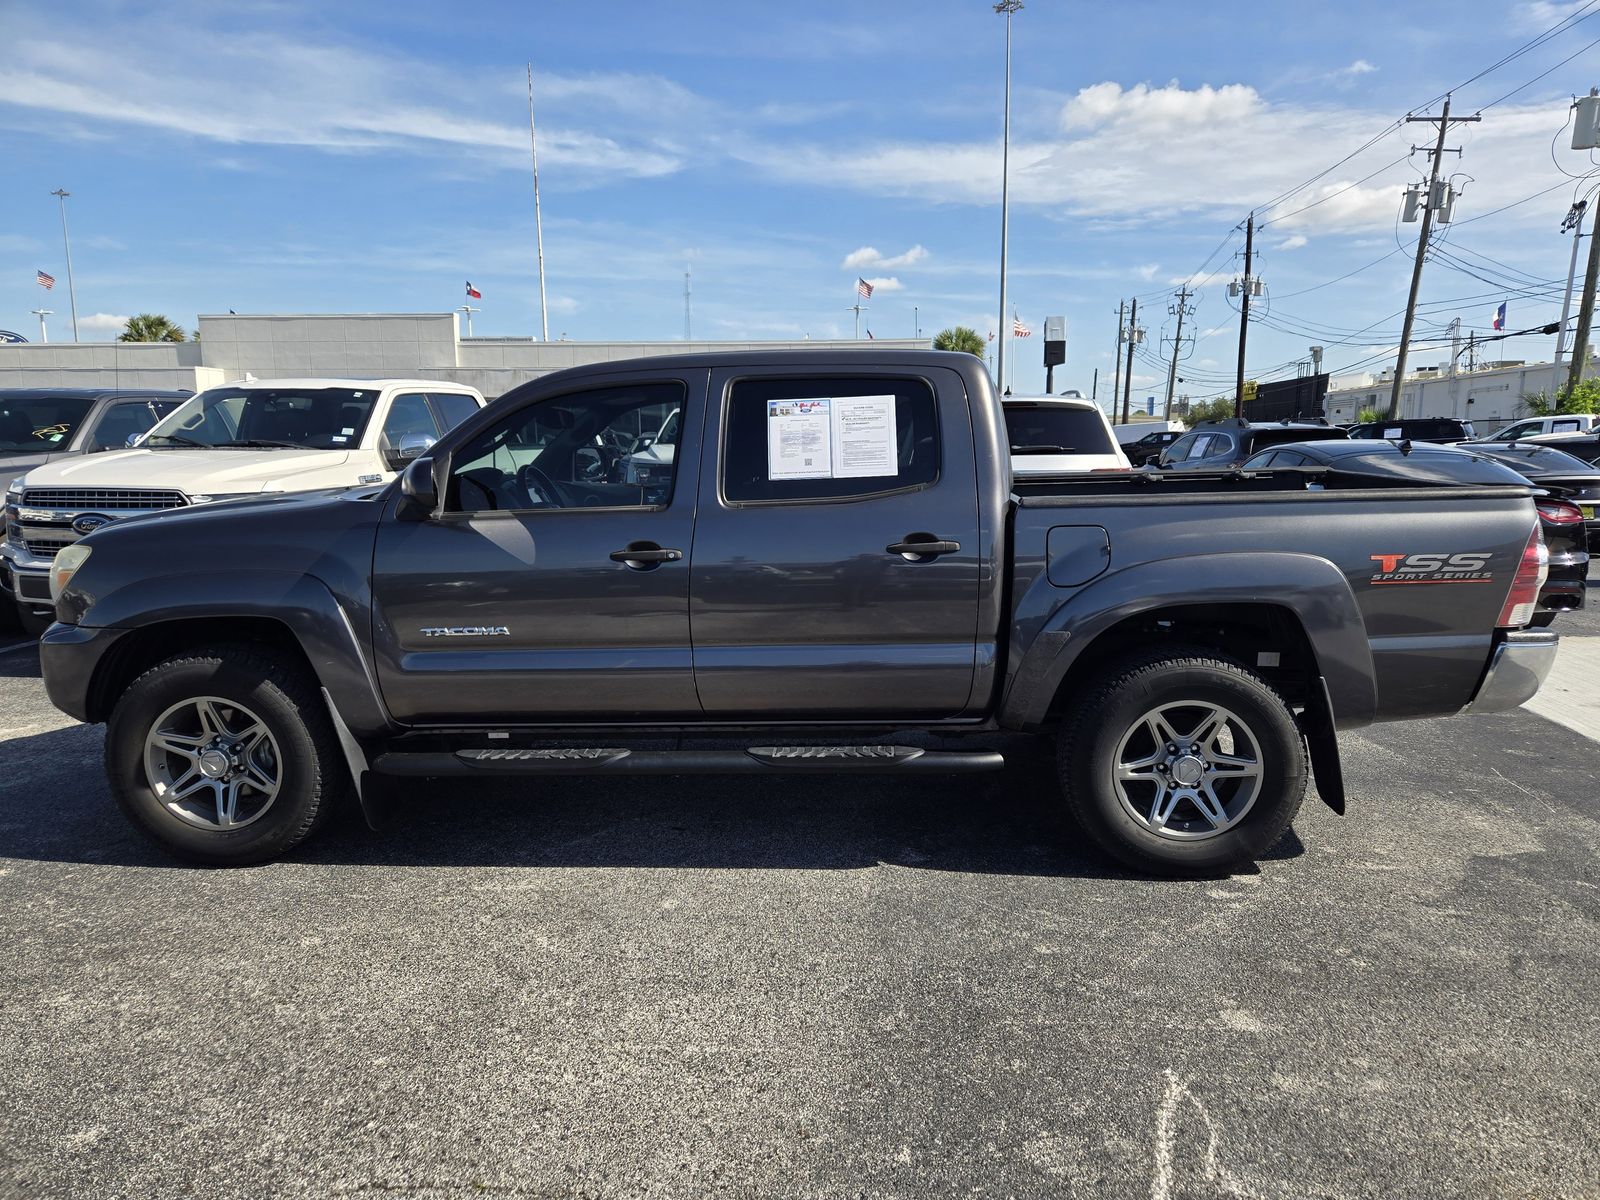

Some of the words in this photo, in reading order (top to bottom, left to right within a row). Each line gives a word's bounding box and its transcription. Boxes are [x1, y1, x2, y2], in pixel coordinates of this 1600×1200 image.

[1370, 553, 1493, 573] TSS
[1371, 573, 1428, 581] SPORT
[1432, 572, 1493, 580] SERIES
[420, 626, 510, 637] TACOMA
